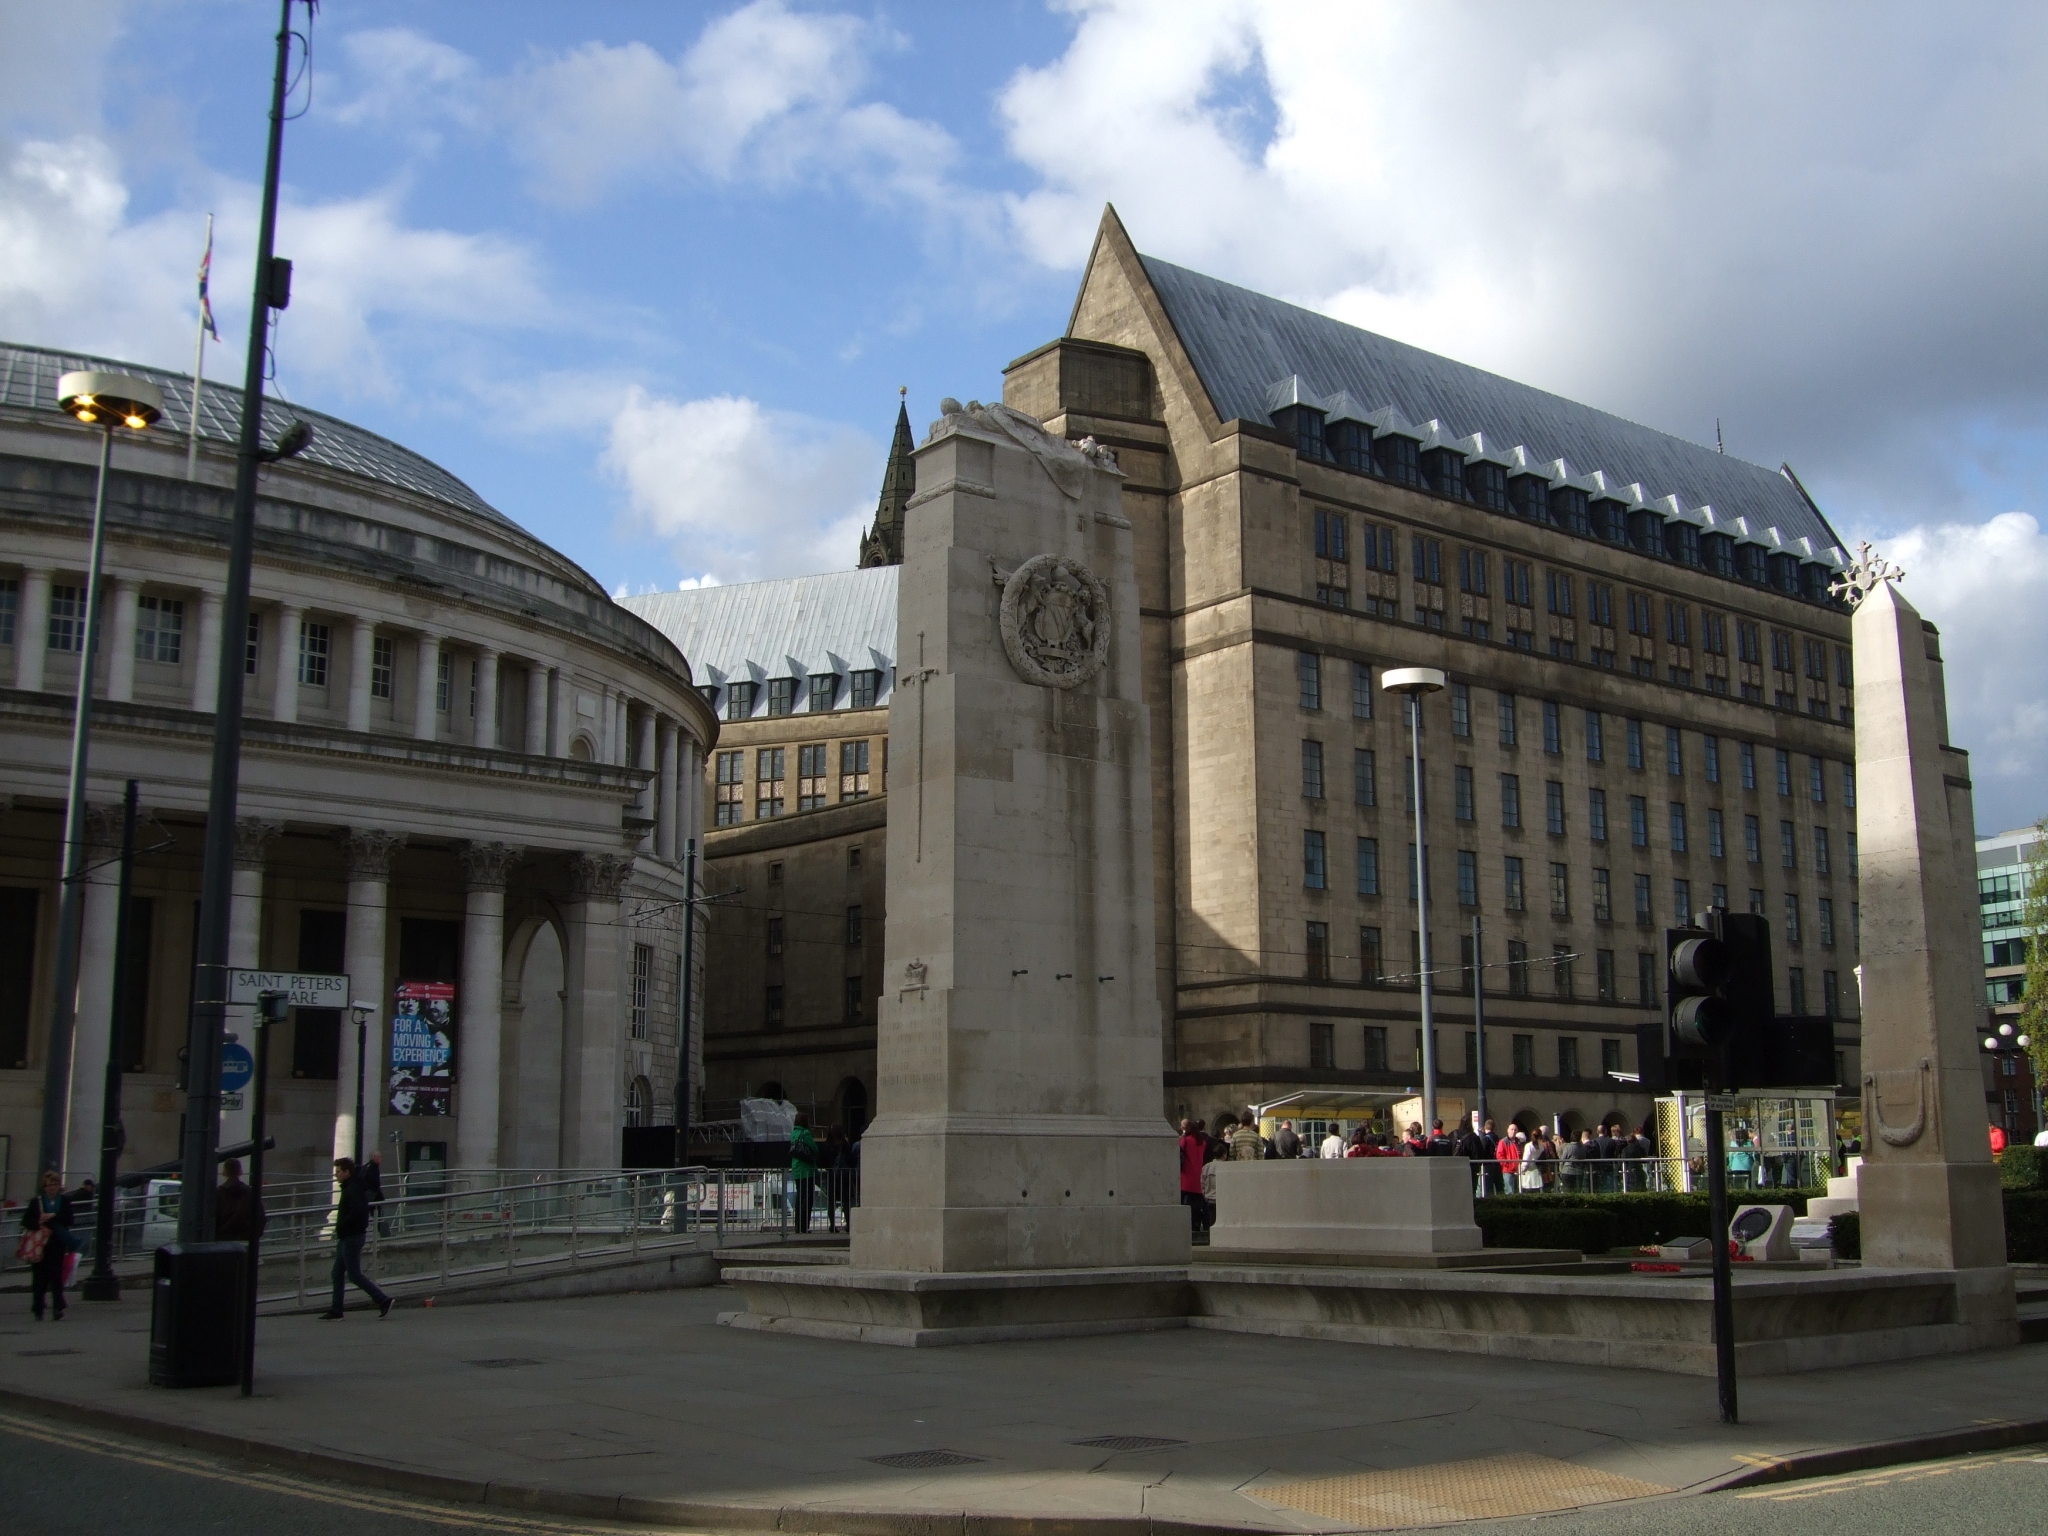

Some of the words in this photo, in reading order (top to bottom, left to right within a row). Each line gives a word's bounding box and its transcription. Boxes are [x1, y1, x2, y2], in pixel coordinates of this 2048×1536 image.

[238, 973, 284, 988] SAINT
[290, 976, 342, 991] PETERS
[288, 991, 318, 1005] ARE
[394, 1018, 412, 1032] FOR
[414, 1019, 422, 1033] A
[393, 1033, 431, 1048] MOVING
[393, 1047, 447, 1063] EXPERIENCE
